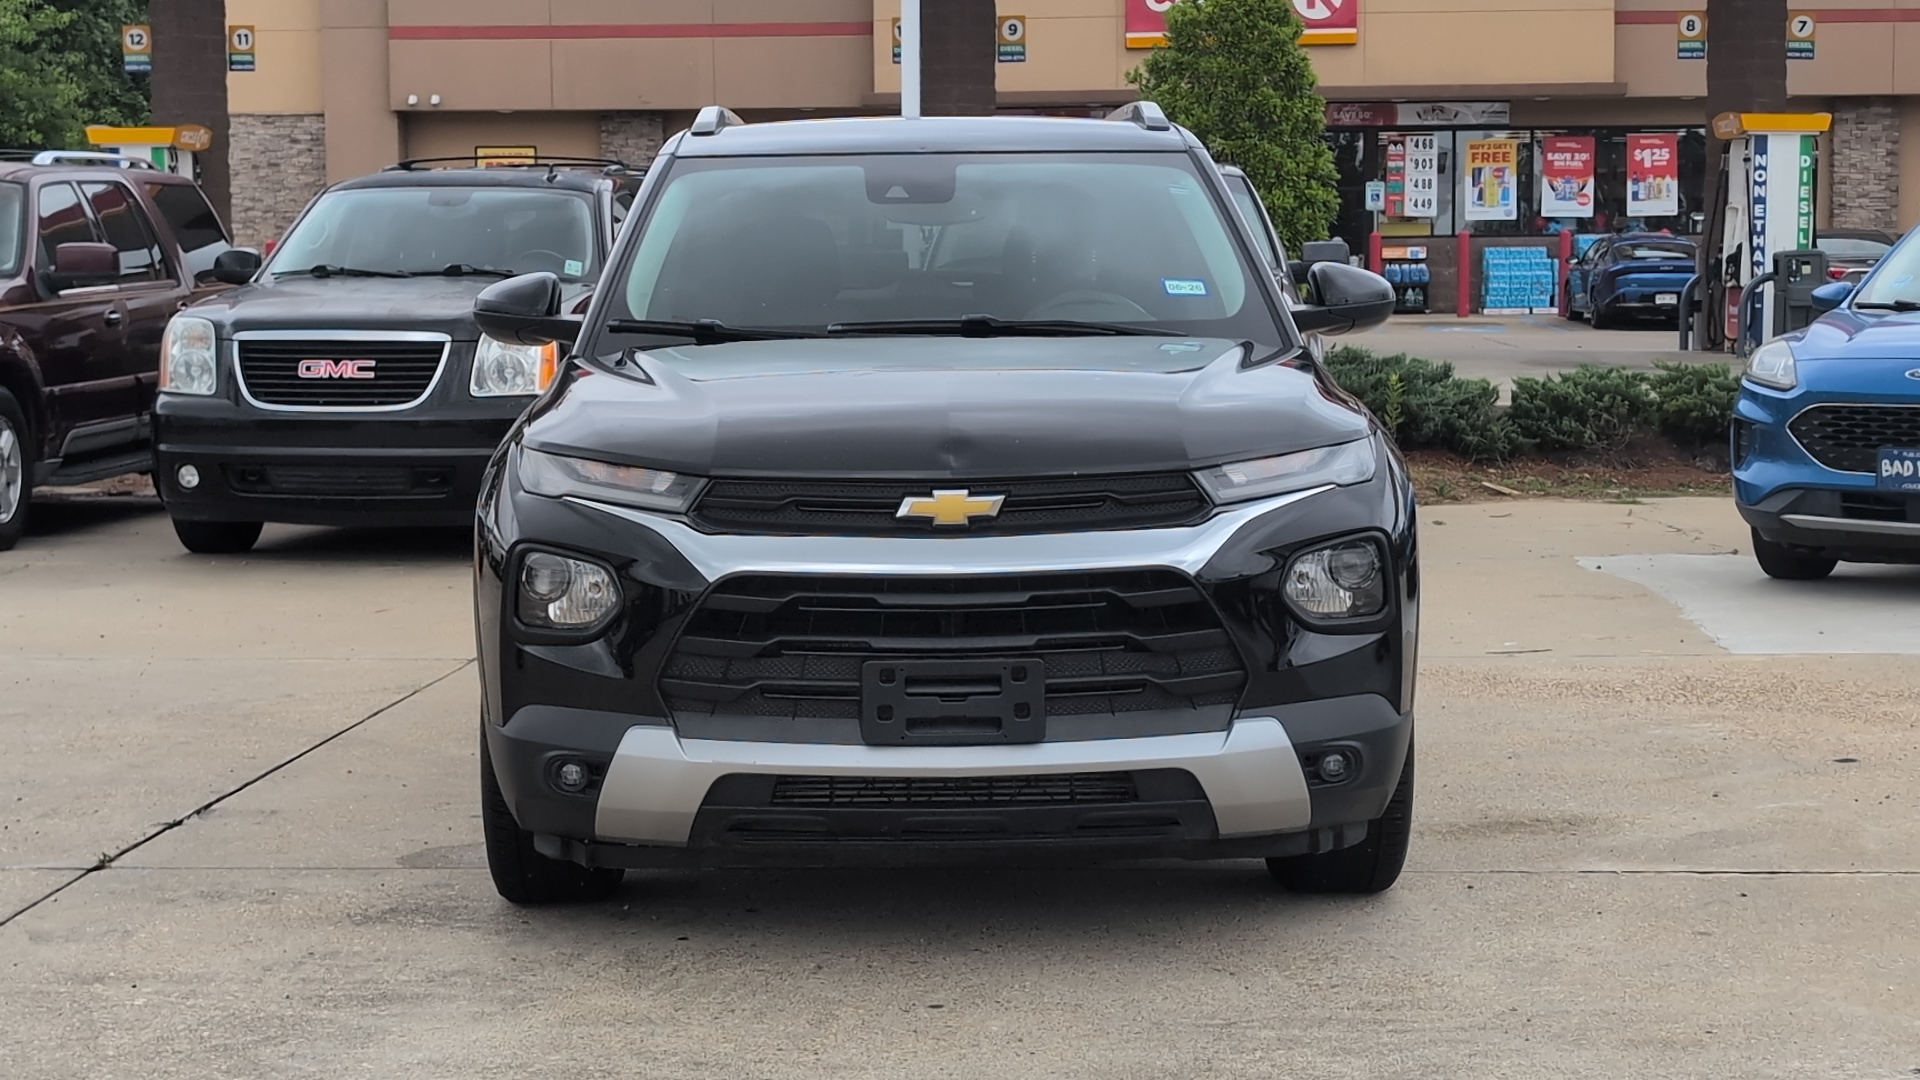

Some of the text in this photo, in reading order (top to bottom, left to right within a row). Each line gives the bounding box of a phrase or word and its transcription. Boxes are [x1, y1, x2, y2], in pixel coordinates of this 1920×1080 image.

[1008, 23, 1018, 36] 9
[1686, 19, 1696, 32] 8
[1797, 20, 1807, 33] 7
[128, 33, 144, 46] 12
[236, 33, 249, 46] 11
[1471, 151, 1511, 163] FREE
[1547, 152, 1572, 161] SAVE
[1754, 153, 1767, 198] NON
[1799, 155, 1811, 244] DIESEL
[298, 359, 376, 379] GMC
[1881, 459, 1914, 478] BAD
